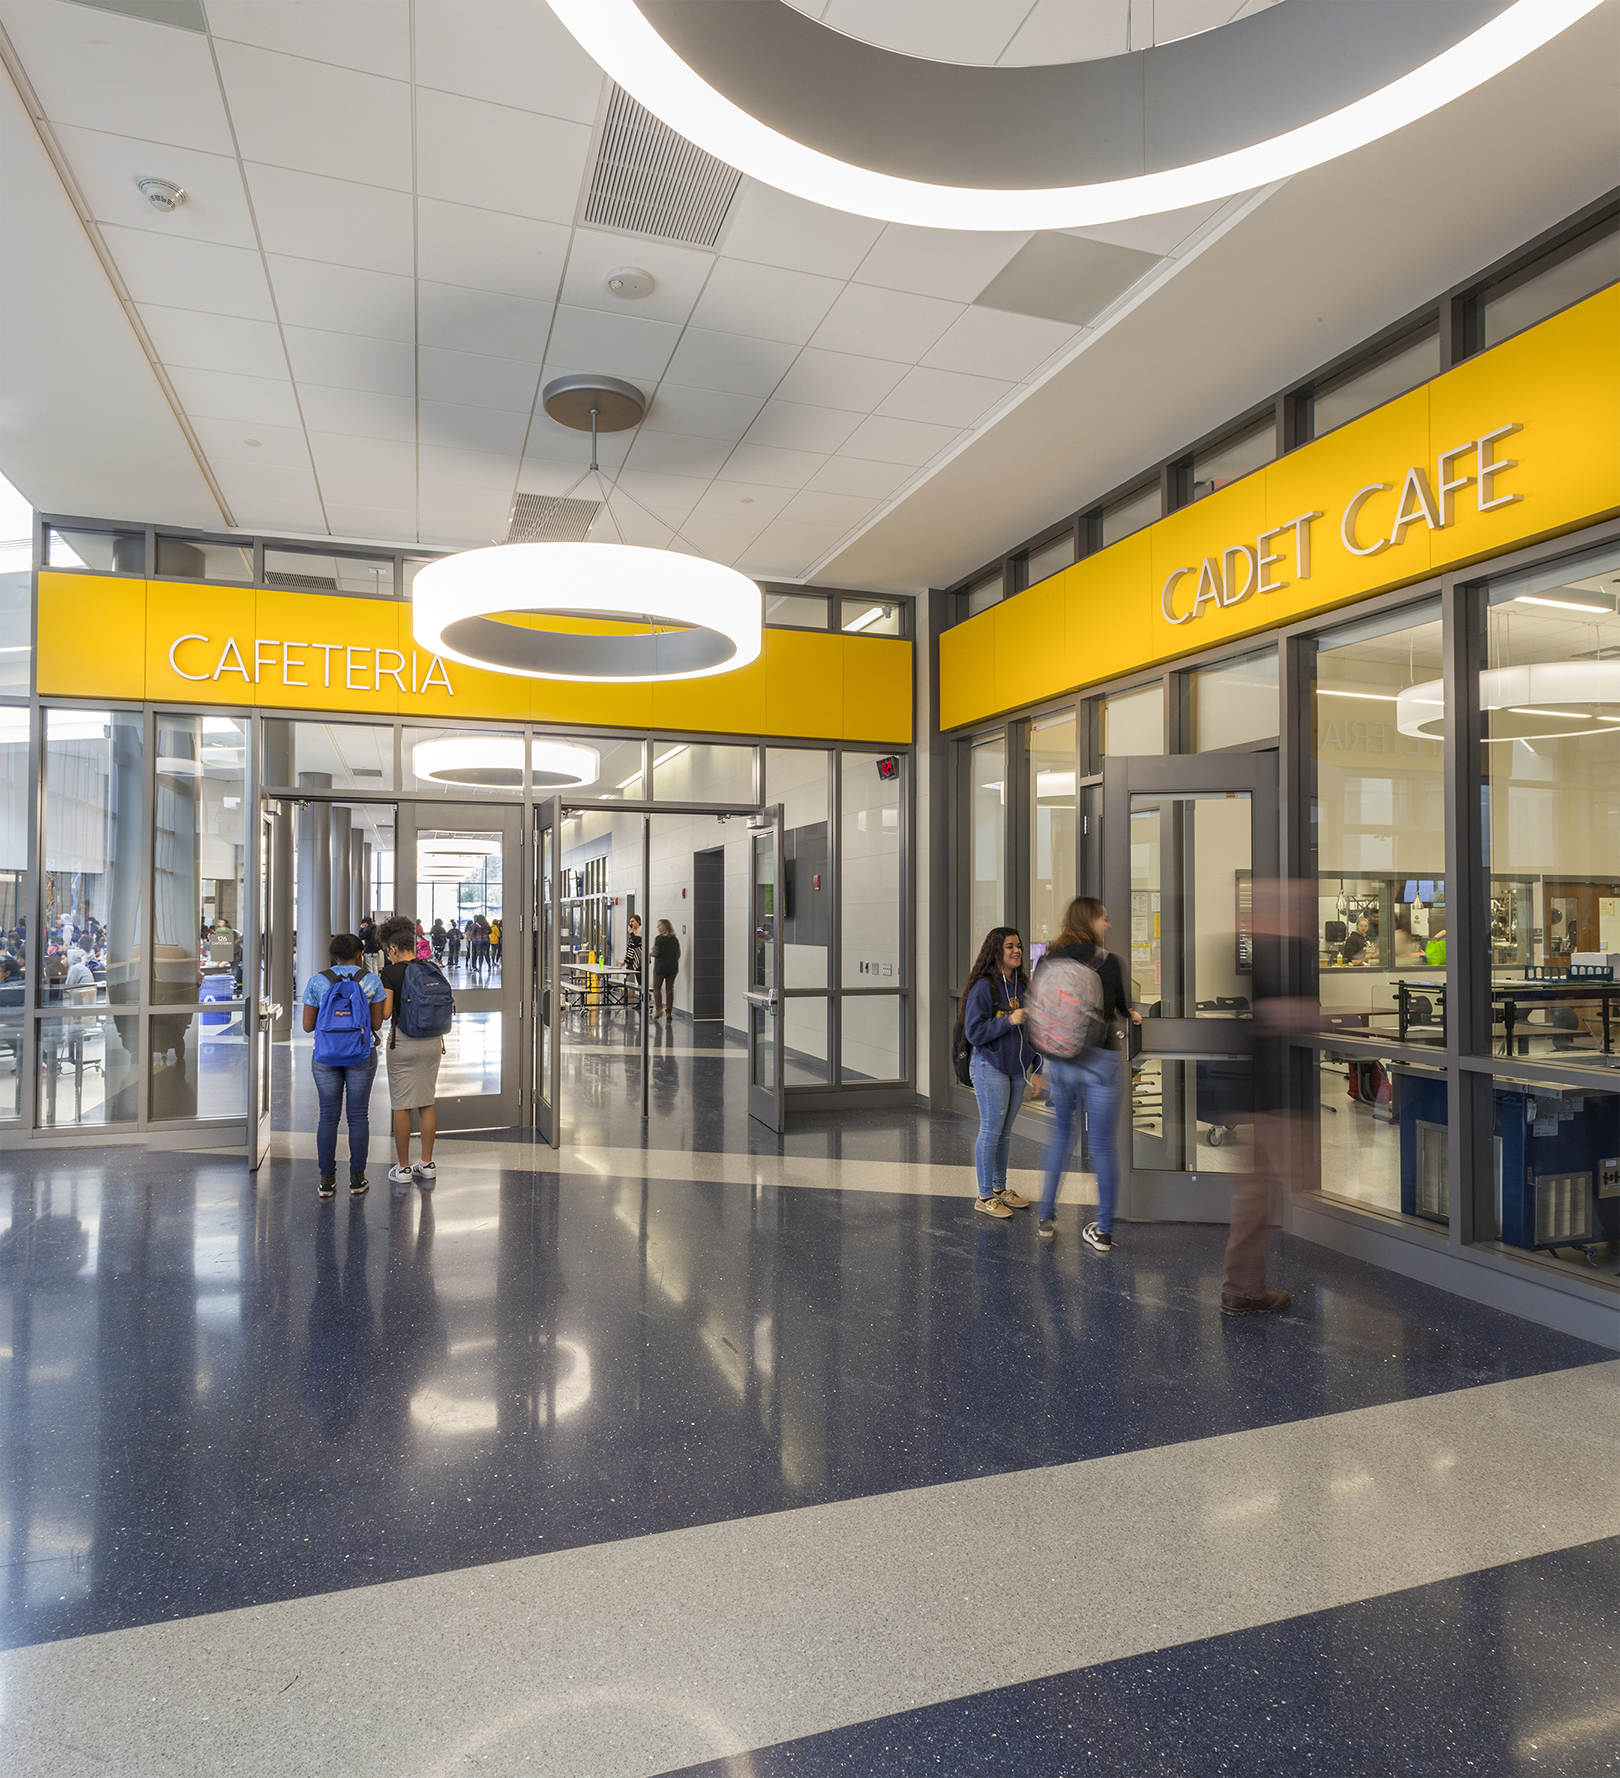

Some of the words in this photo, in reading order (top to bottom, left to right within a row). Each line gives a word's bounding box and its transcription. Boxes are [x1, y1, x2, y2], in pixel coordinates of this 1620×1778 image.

[1161, 510, 1323, 625] CADET
[1340, 422, 1524, 556] CAFE
[169, 633, 454, 697] CAFETERIA
